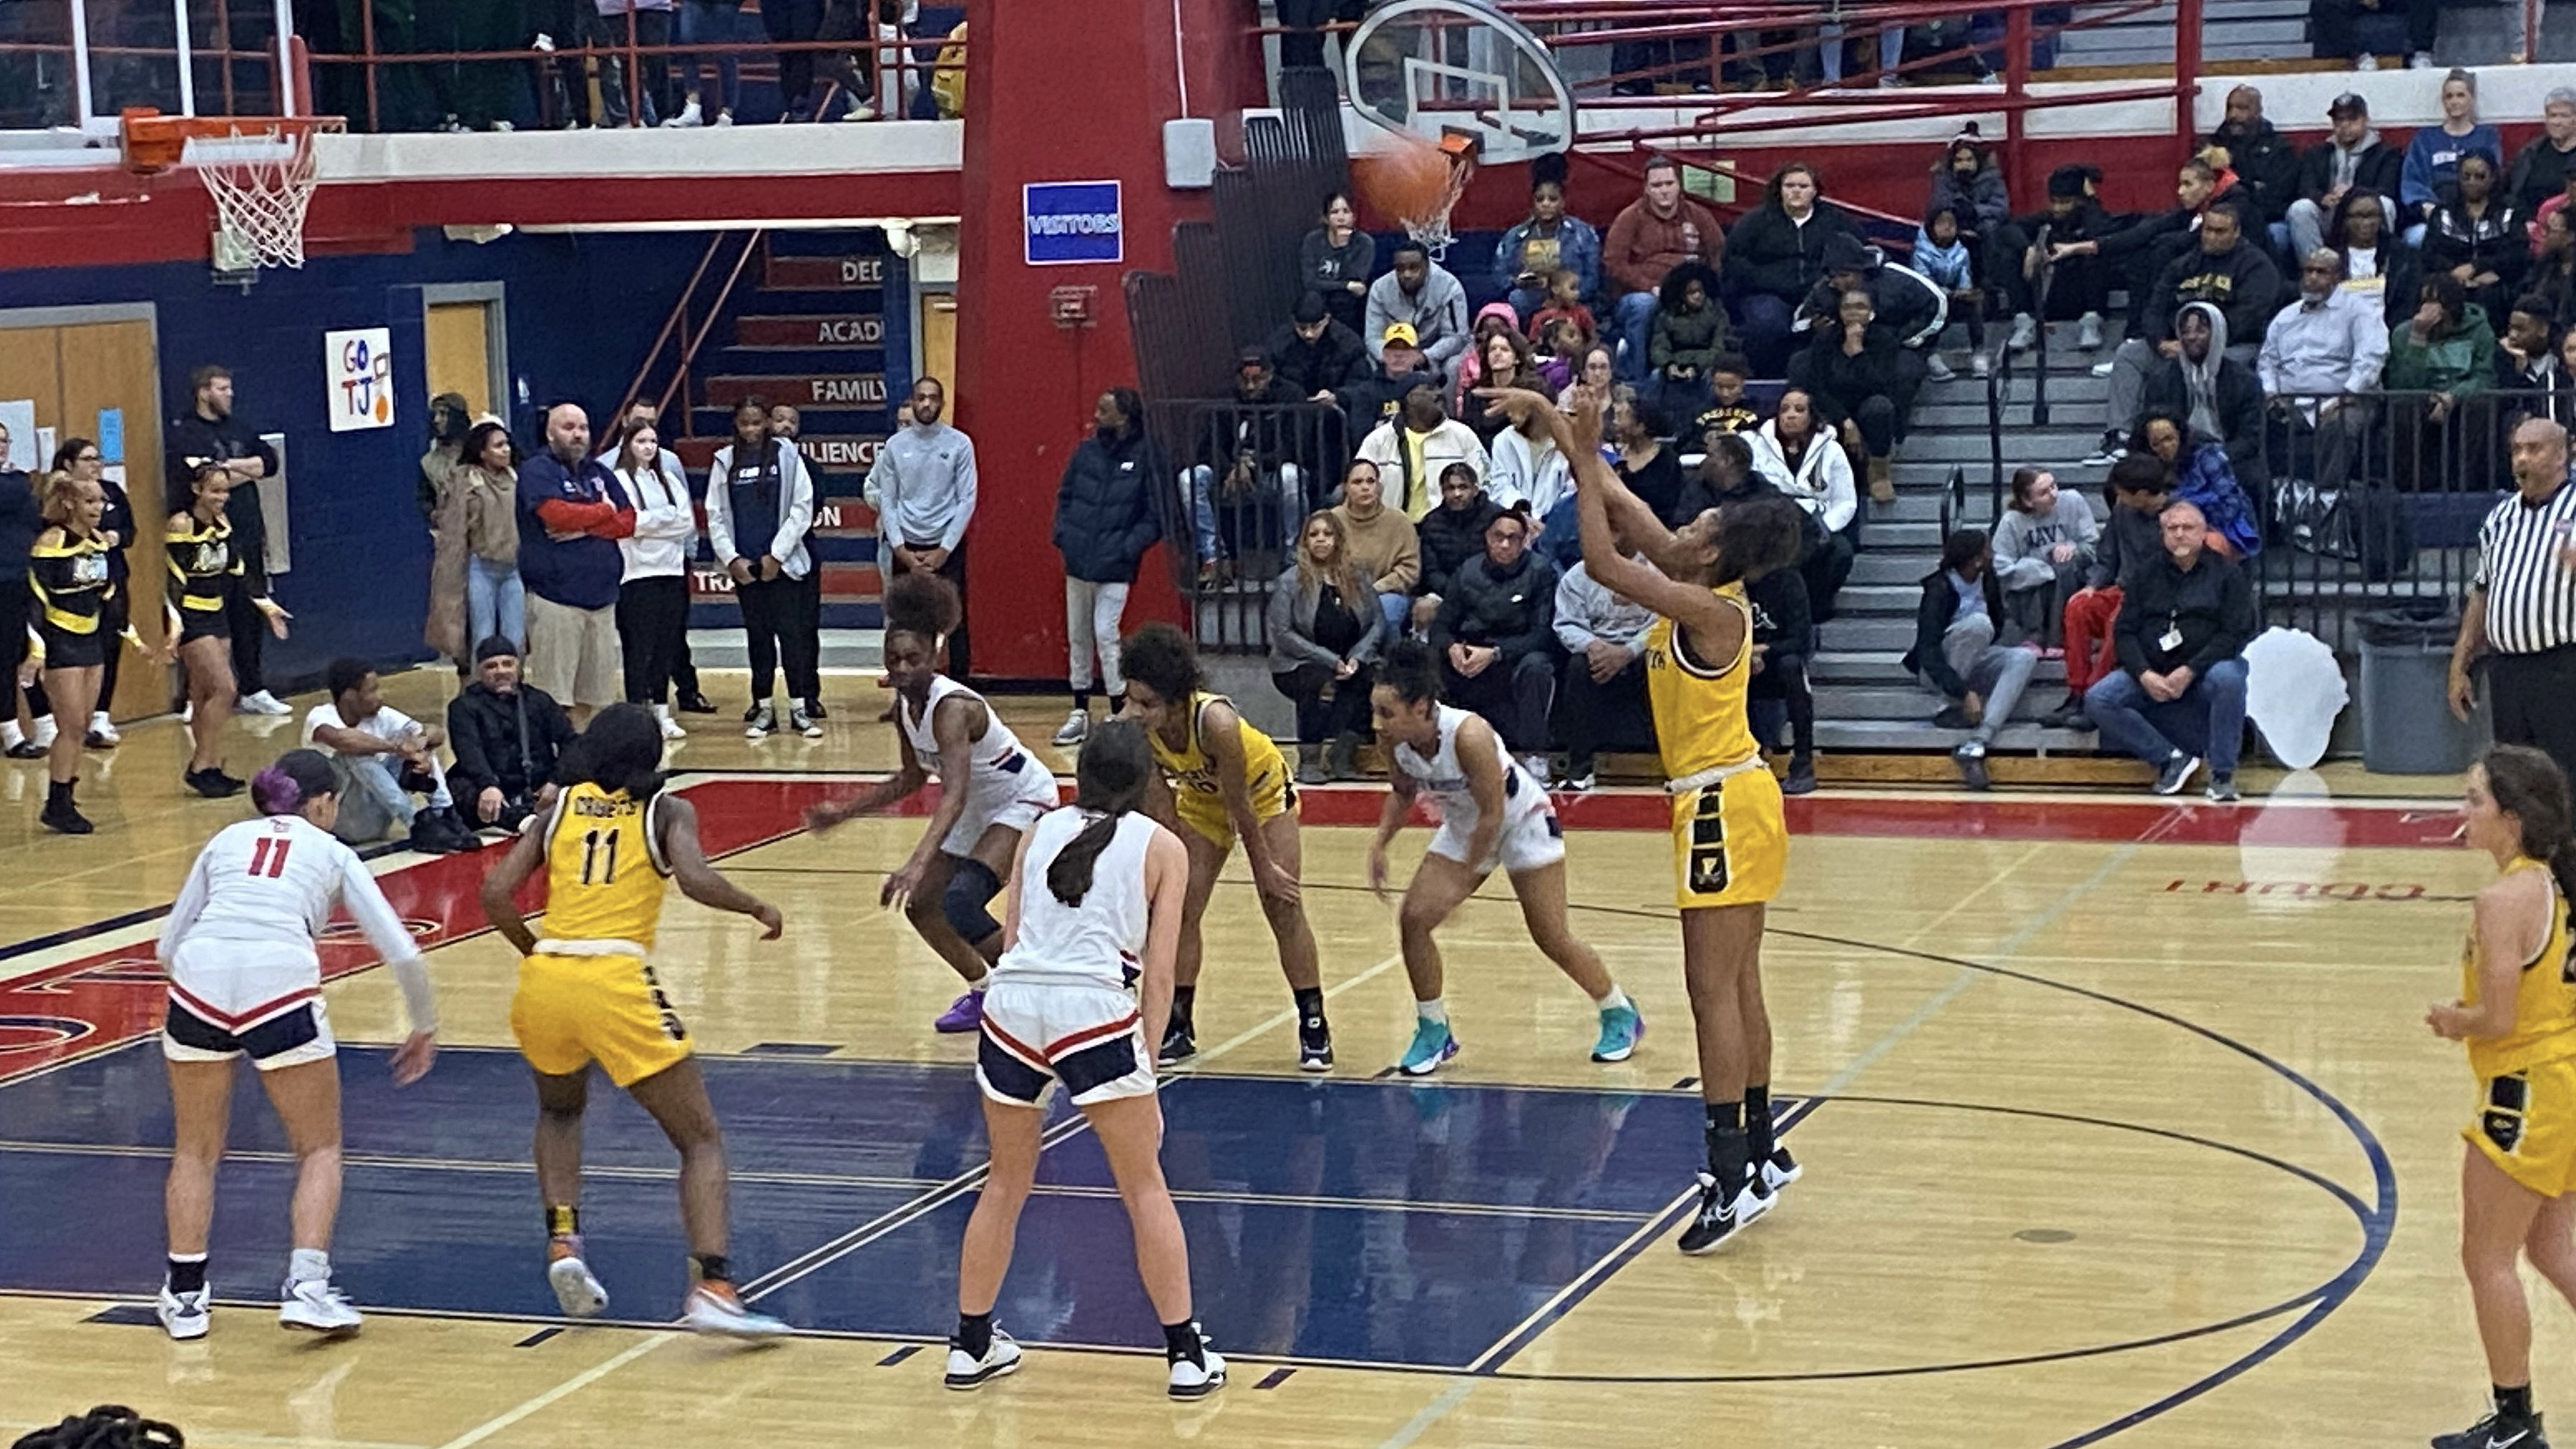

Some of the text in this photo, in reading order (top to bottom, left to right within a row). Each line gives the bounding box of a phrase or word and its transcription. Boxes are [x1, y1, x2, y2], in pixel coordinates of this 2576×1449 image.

[818, 320, 885, 342] ACAD
[344, 340, 369, 372] GO
[341, 376, 373, 415] TJ
[249, 837, 293, 878] 11
[581, 827, 620, 886] 11
